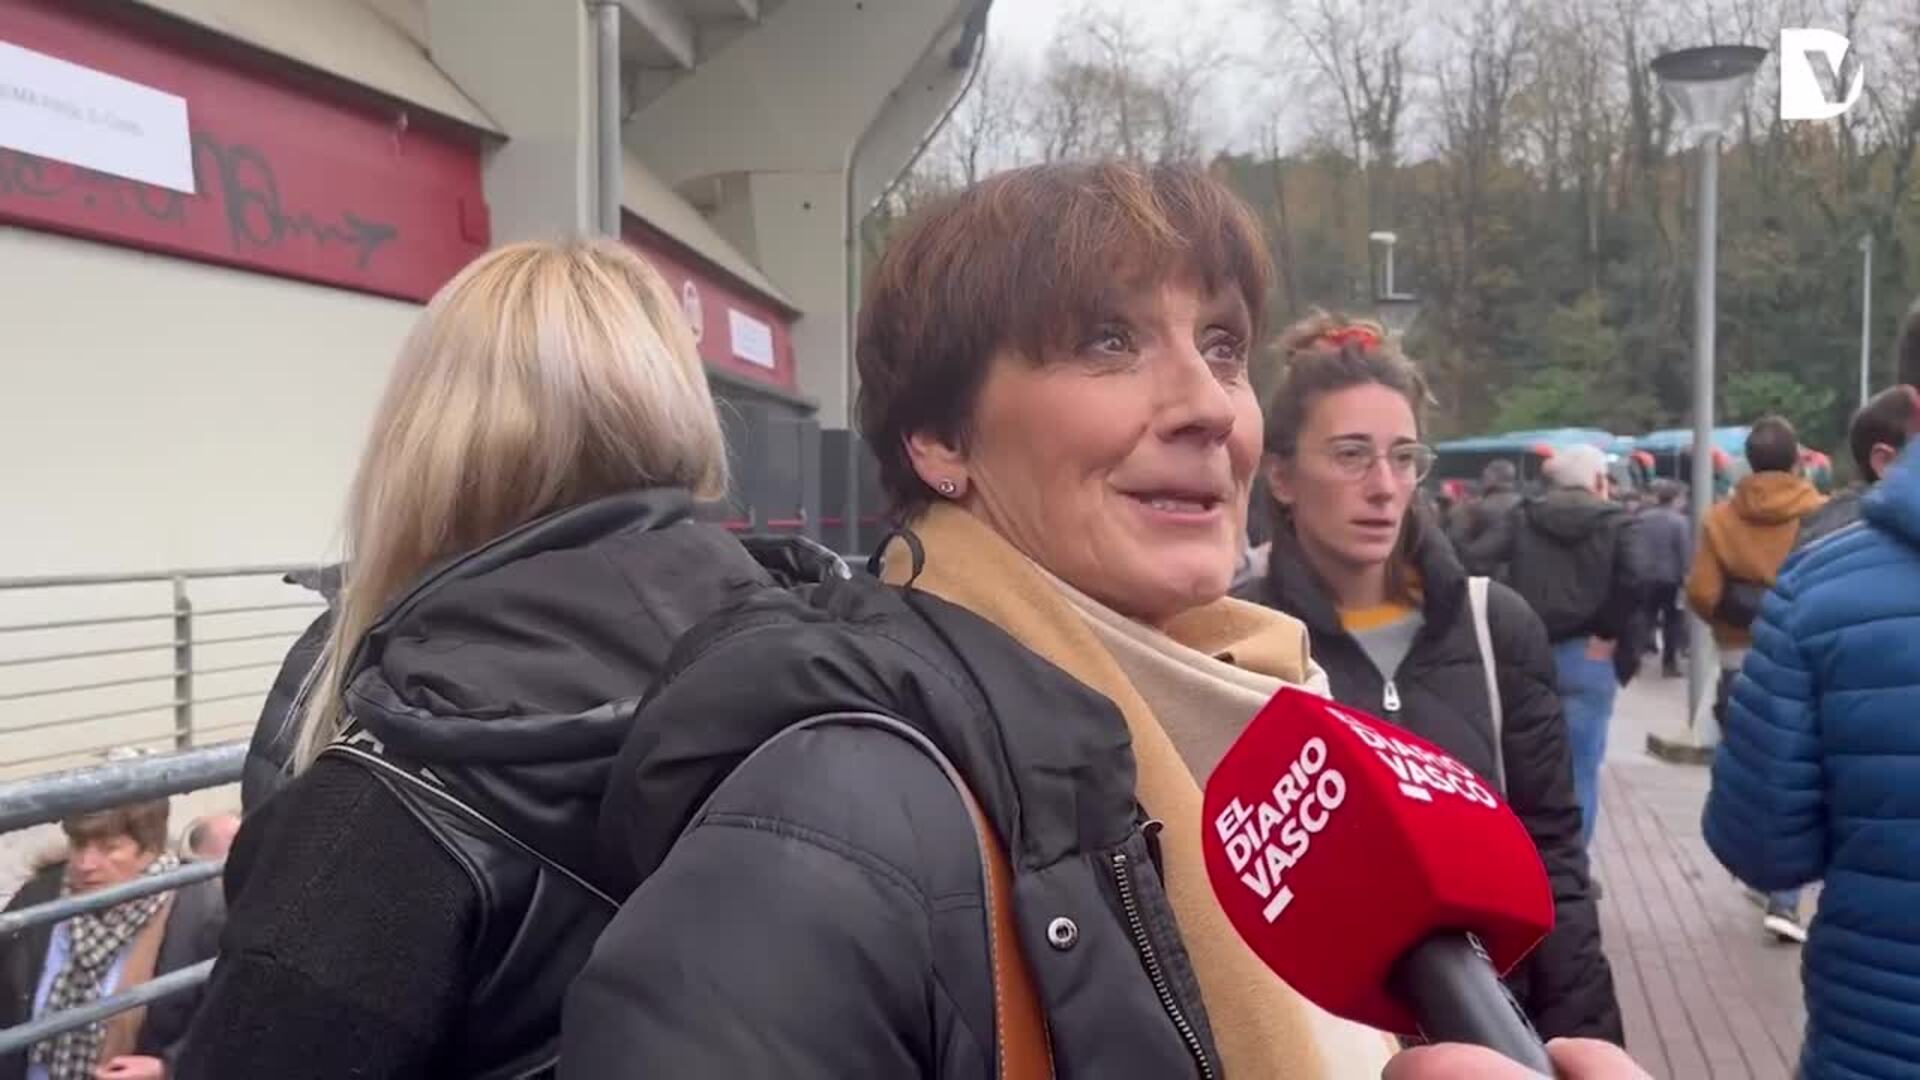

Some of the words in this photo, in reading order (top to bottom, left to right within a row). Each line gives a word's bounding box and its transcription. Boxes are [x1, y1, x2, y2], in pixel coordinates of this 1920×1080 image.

[1214, 796, 1254, 844] EL
[1224, 736, 1328, 874] DIARIO
[1376, 750, 1498, 809] VASCO
[1239, 768, 1347, 899] VASCO
